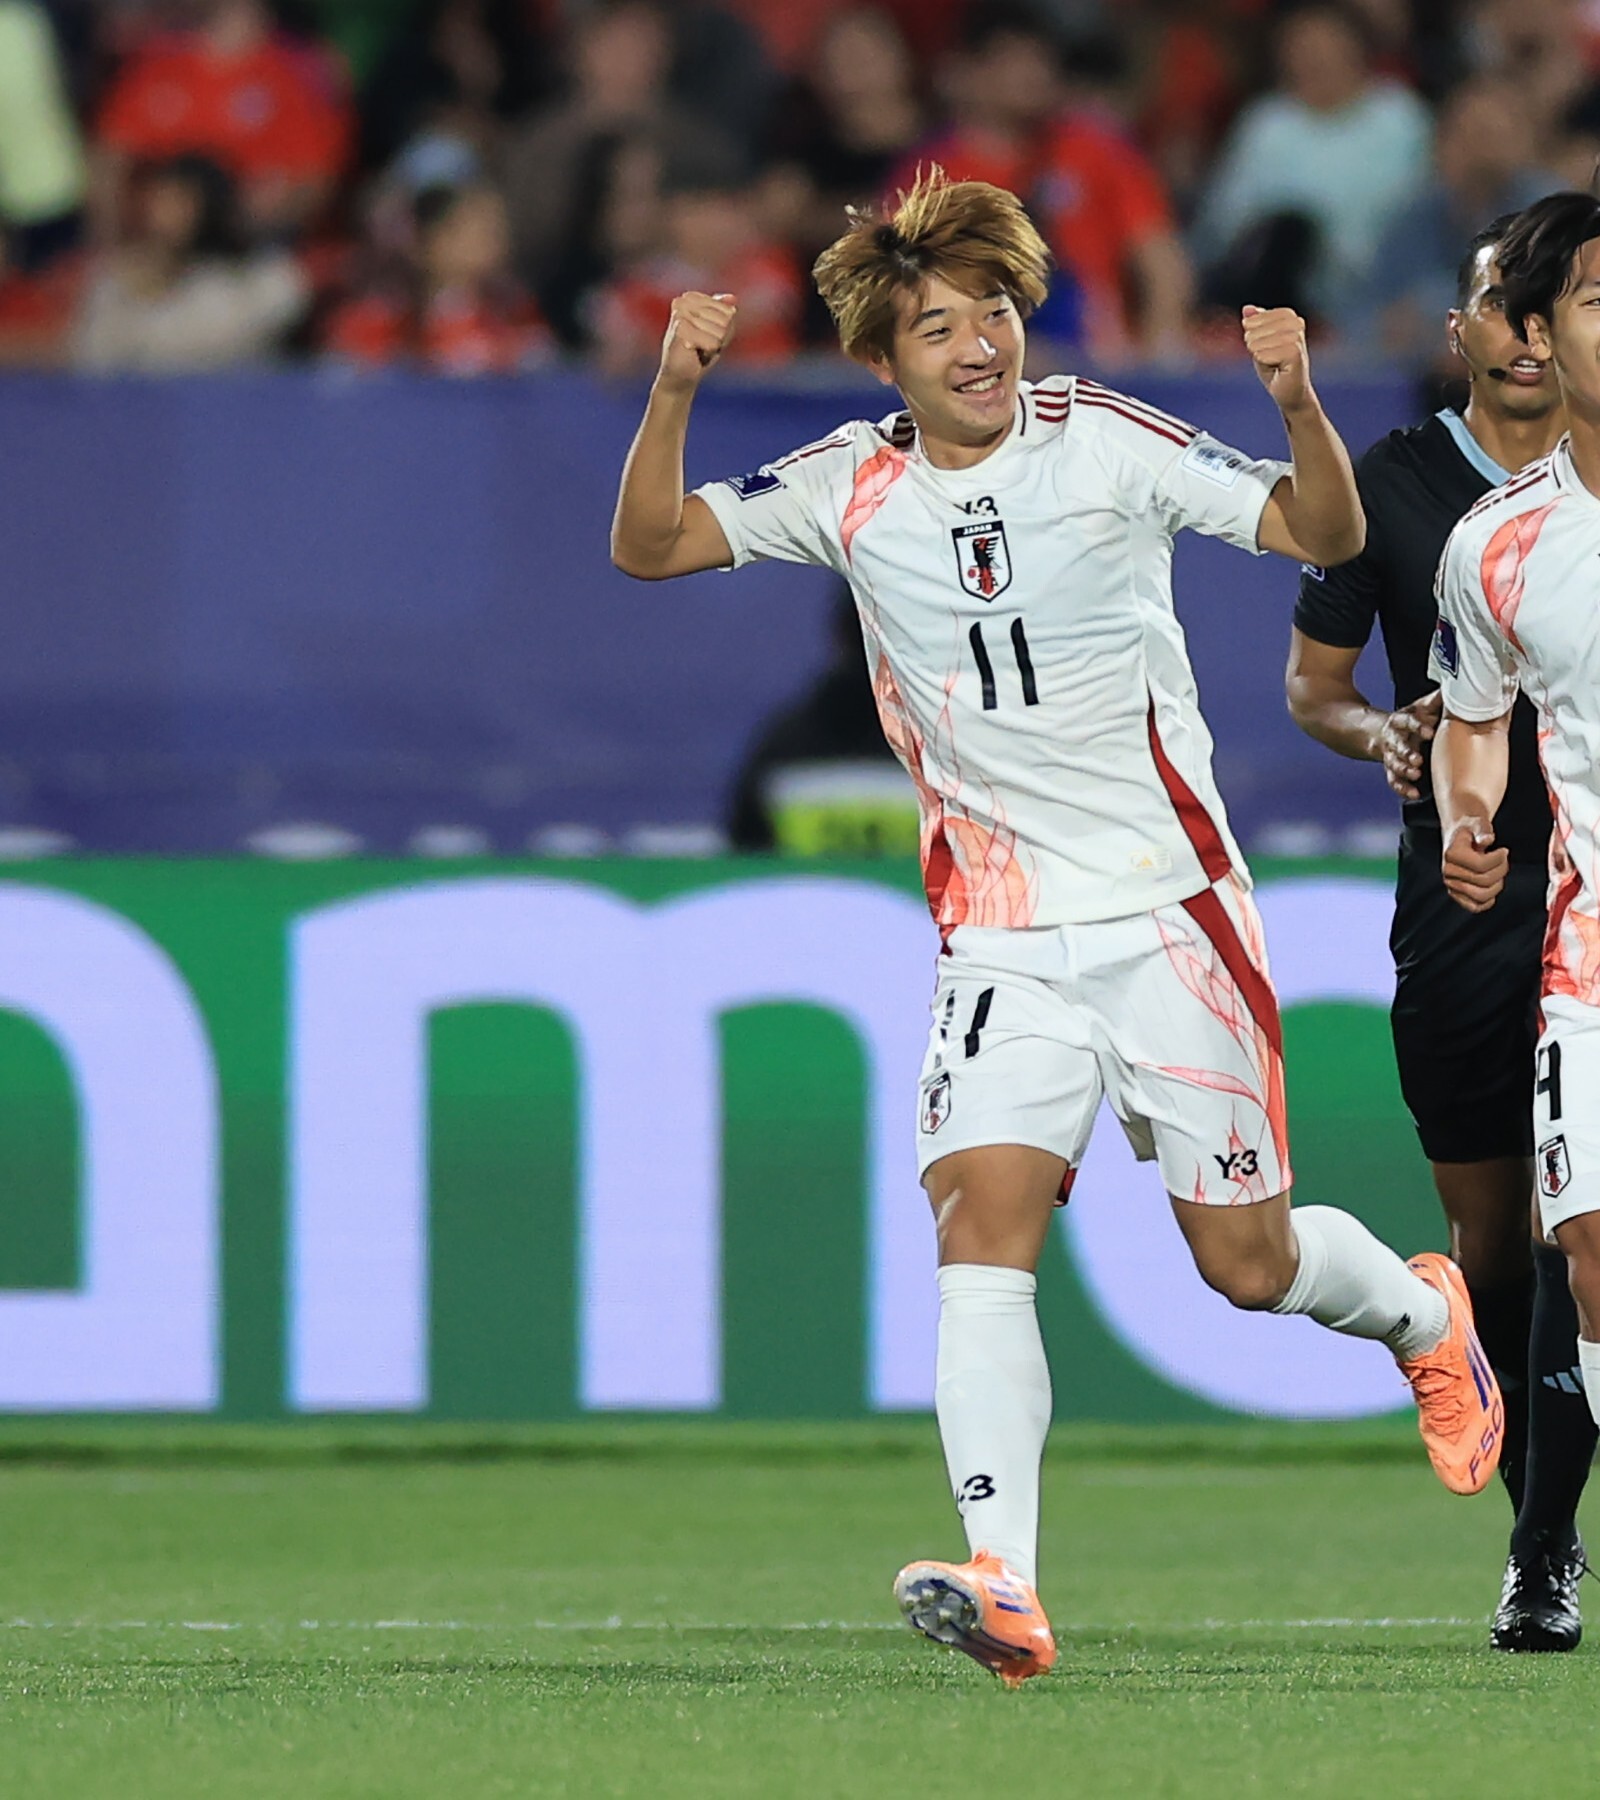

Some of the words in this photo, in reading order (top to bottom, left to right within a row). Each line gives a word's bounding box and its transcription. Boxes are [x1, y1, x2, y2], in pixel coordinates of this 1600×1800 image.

[962, 523, 993, 536] JAPAN
[968, 616, 1040, 711] 11
[1212, 1148, 1259, 1180] Y-3
